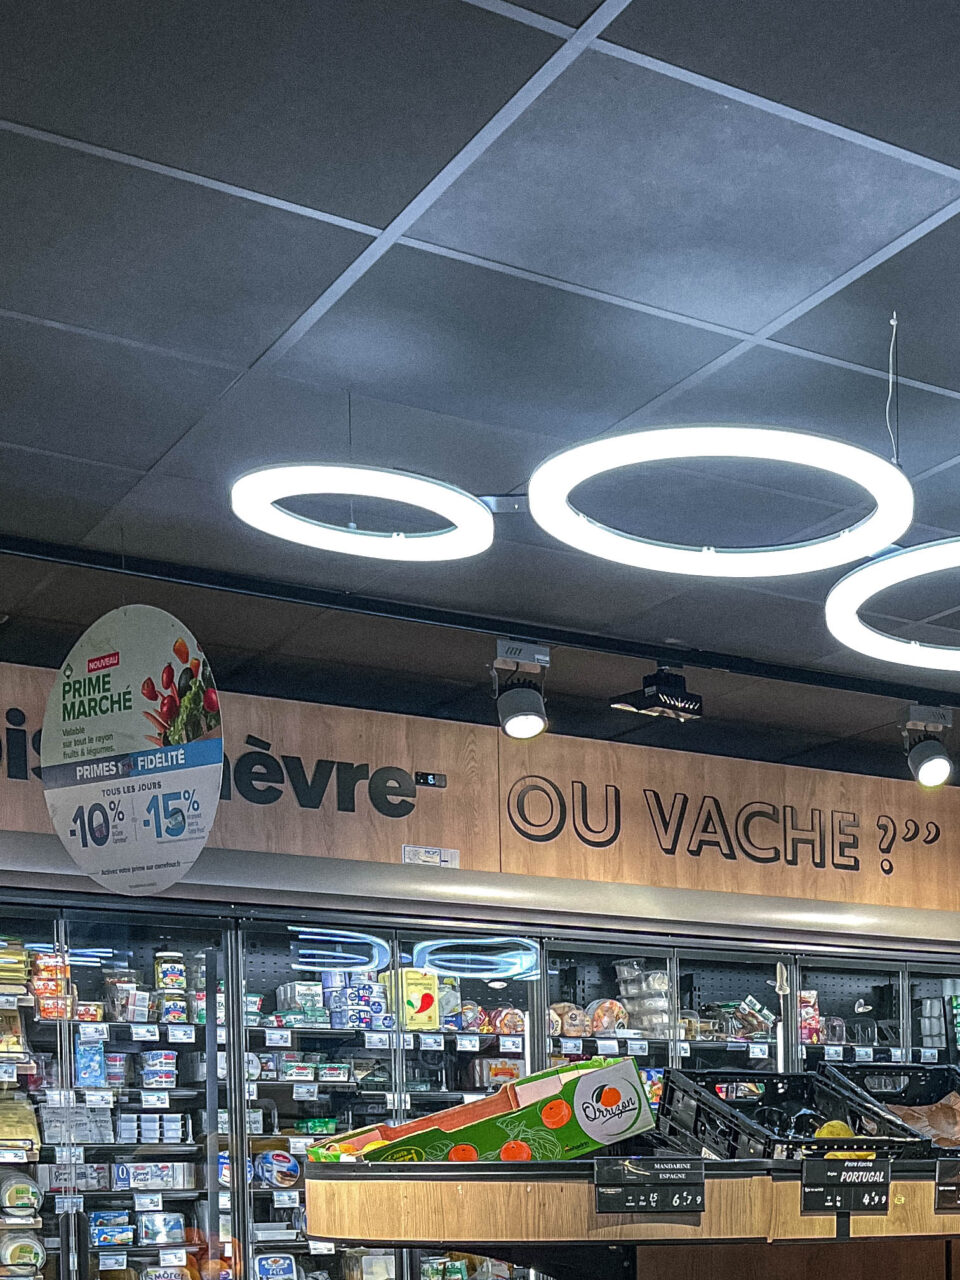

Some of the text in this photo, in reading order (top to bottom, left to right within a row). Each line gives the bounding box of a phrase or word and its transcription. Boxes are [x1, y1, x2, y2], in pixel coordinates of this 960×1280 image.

[88, 655, 118, 670] NOUVEAU
[62, 673, 111, 701] PRIME
[62, 684, 132, 722] MARCHÉ
[94, 733, 114, 746] rayon
[76, 749, 185, 780] PRIMES FIDÉLITÉ
[101, 781, 162, 798] TOUS LES JOURS
[506, 774, 622, 849] OU
[643, 788, 860, 872] VACHE
[840, 1171, 884, 1182] PORTUGAL
